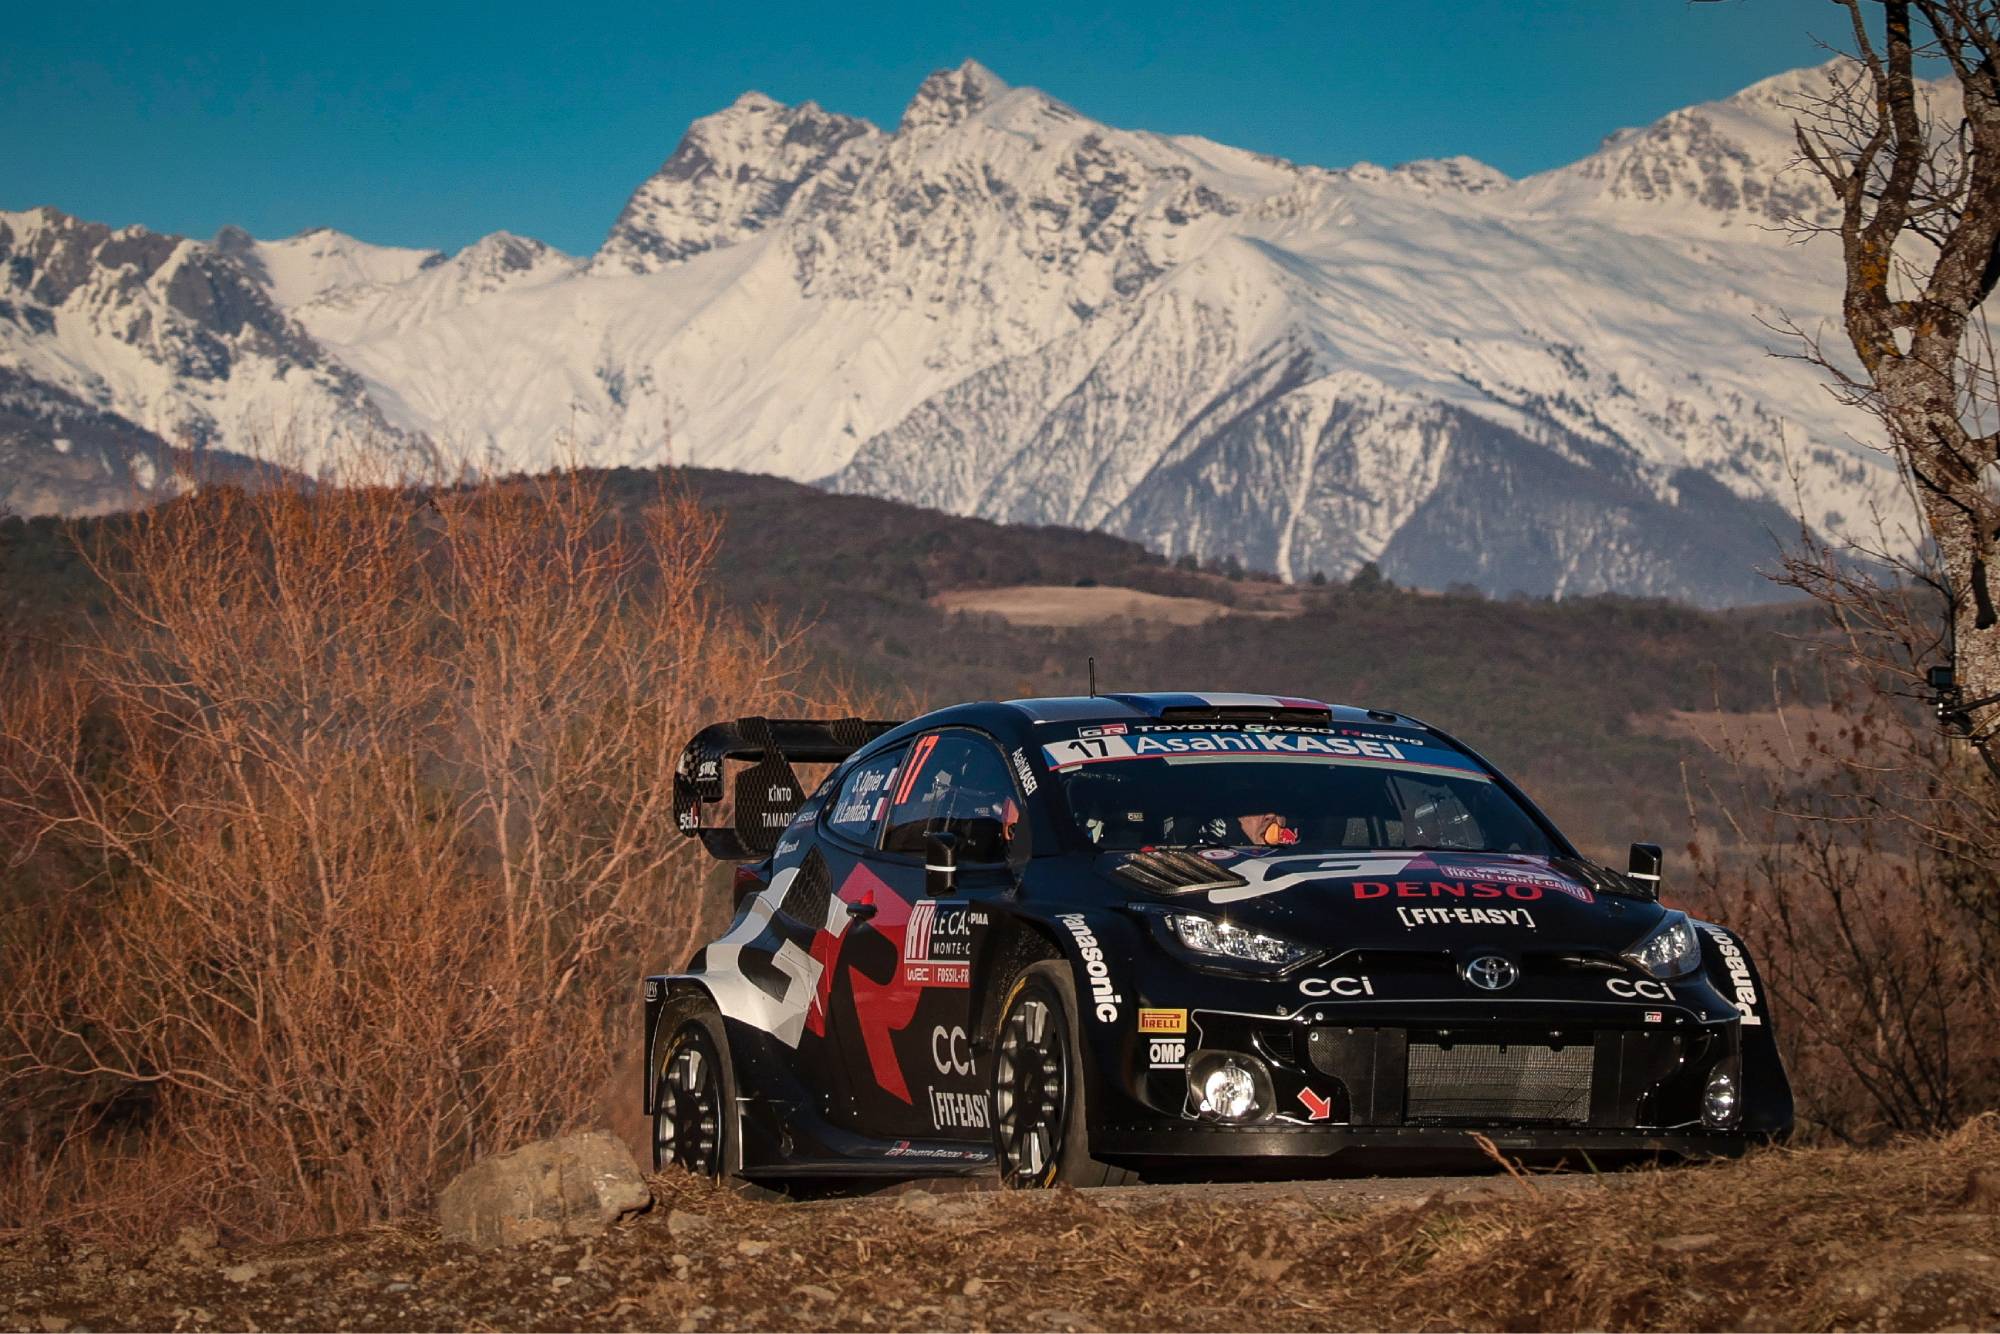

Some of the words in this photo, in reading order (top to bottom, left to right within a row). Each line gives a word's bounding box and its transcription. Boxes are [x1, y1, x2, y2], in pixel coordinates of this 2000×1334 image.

[1134, 724, 1239, 732] TOYOTA
[1243, 723, 1335, 734] GAZOO
[1068, 738, 1109, 758] 17
[1137, 734, 1405, 760] AsahiKASEI
[895, 735, 940, 805] 17
[1352, 882, 1543, 900] DENSO
[937, 967, 969, 983] FOSSIL-FR
[1054, 913, 1123, 1023] Panasonic
[1700, 924, 1762, 1026] Panason
[1141, 1012, 1182, 1029] PIRELLI
[1150, 1043, 1186, 1063] OMP
